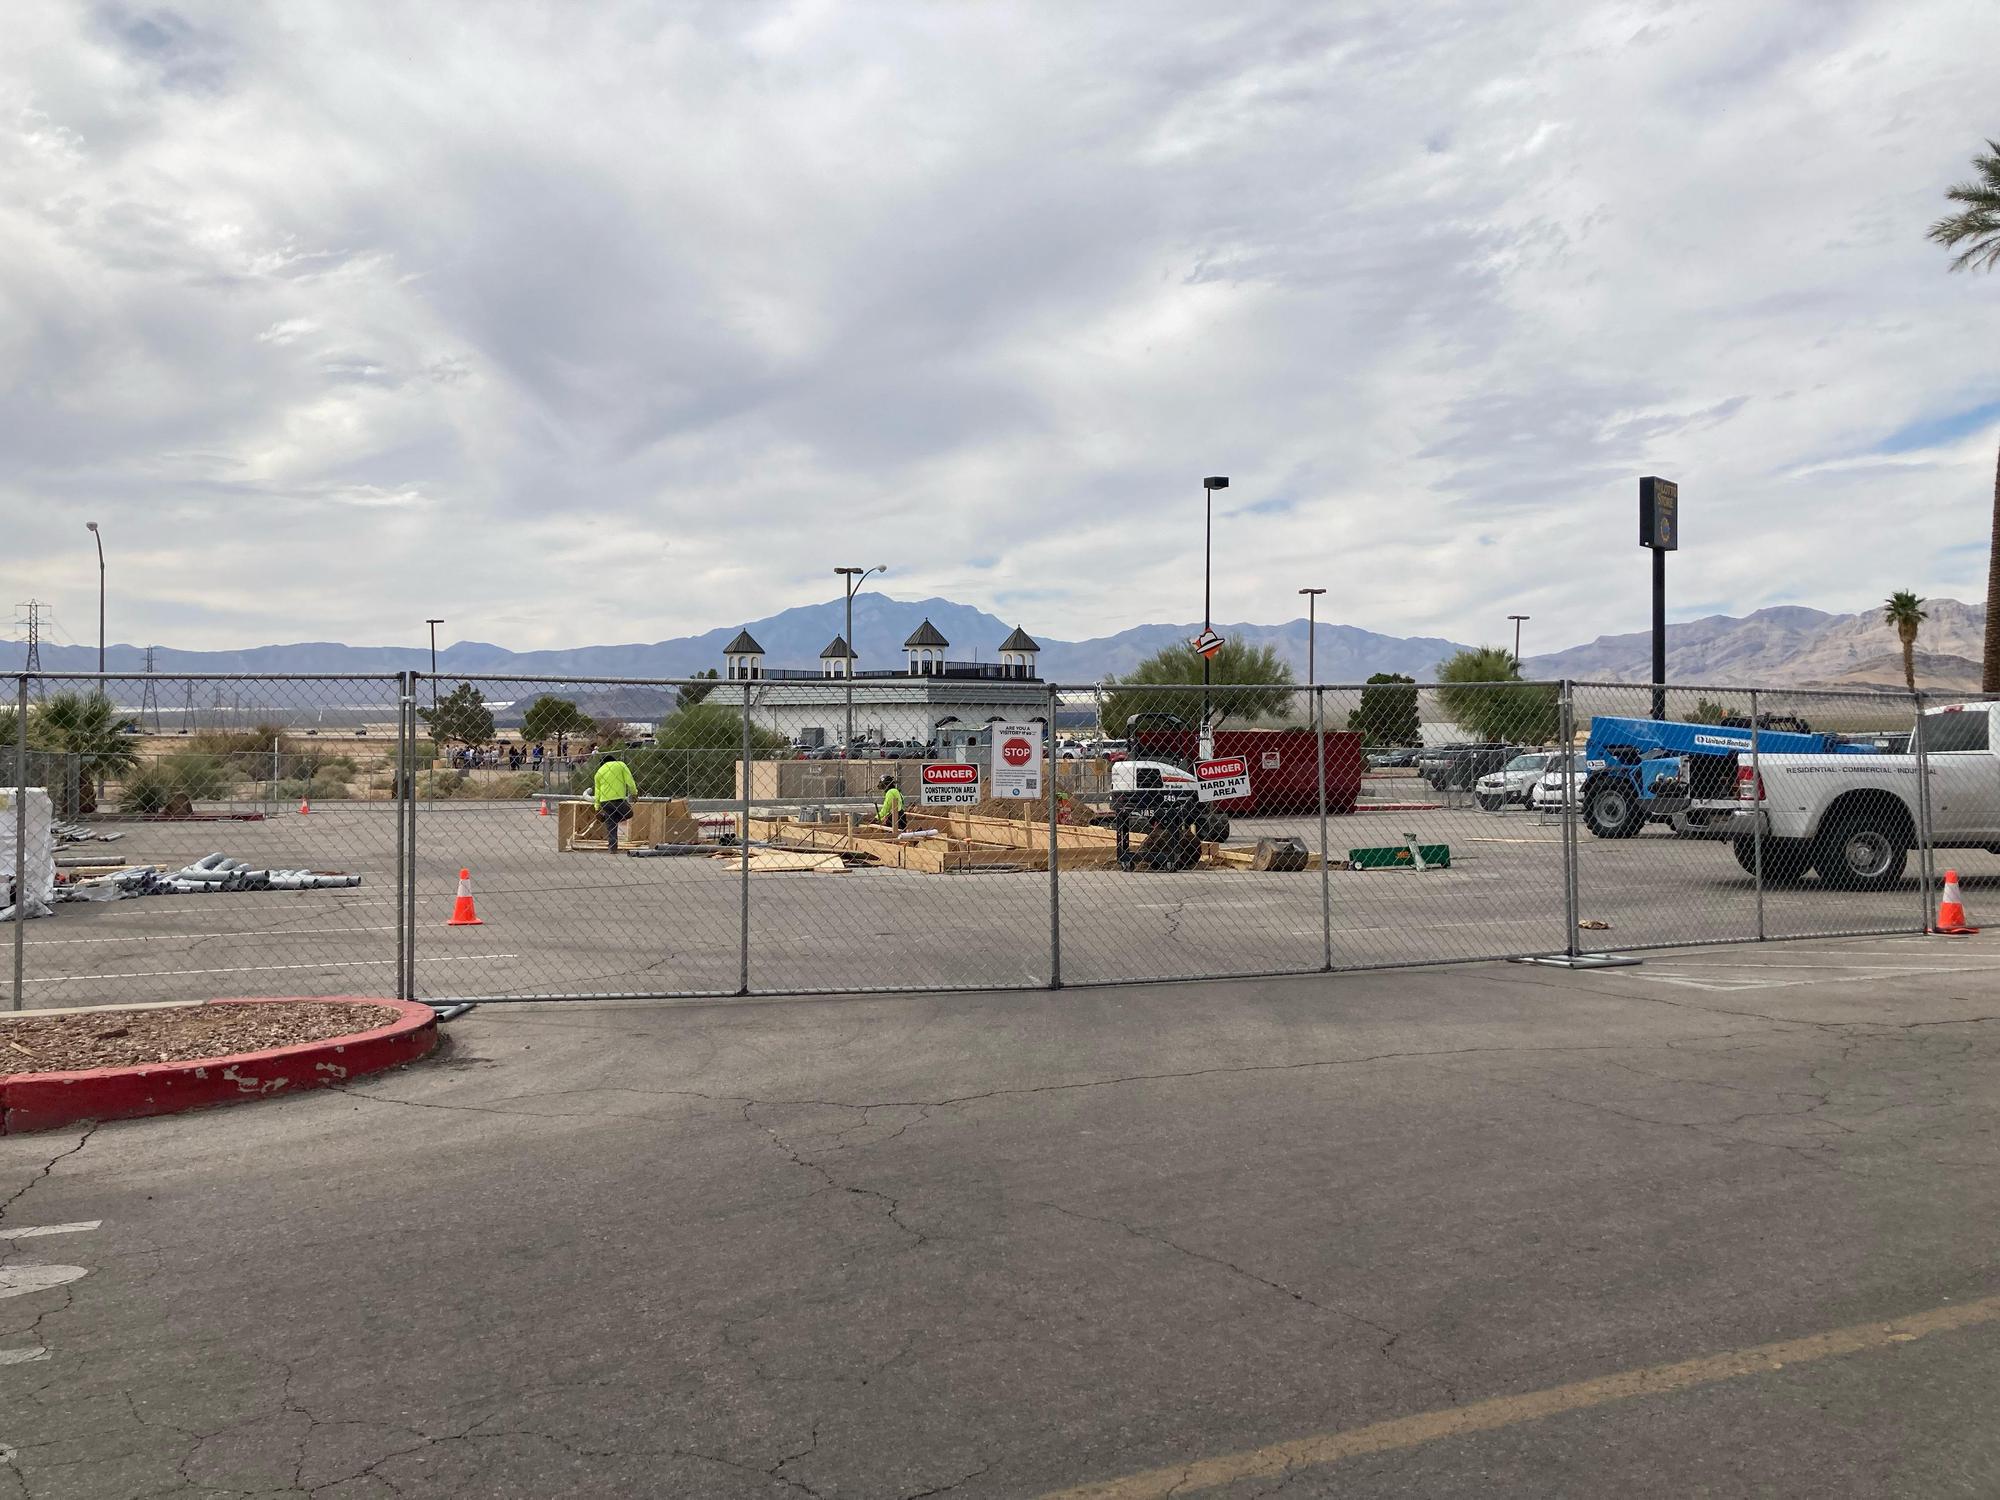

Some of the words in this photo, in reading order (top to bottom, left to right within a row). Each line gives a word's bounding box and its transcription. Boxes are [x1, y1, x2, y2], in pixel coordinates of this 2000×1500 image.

[1705, 737, 1726, 745] United
[1727, 739, 1749, 748] Rentals
[1004, 747, 1030, 757] STOP
[927, 769, 973, 779] DANGER
[1200, 763, 1241, 776] DANGER
[1786, 766, 1837, 775] RESIDENTIAL
[1842, 766, 1892, 774] COMMERCIAL
[1200, 780, 1225, 790] HARD
[1228, 778, 1246, 787] HAT
[925, 786, 962, 794] CONSTRUCTION
[963, 786, 976, 794] AREA
[1213, 787, 1237, 797] AREA
[927, 795, 952, 803] KEEP
[955, 795, 975, 803] OUT
